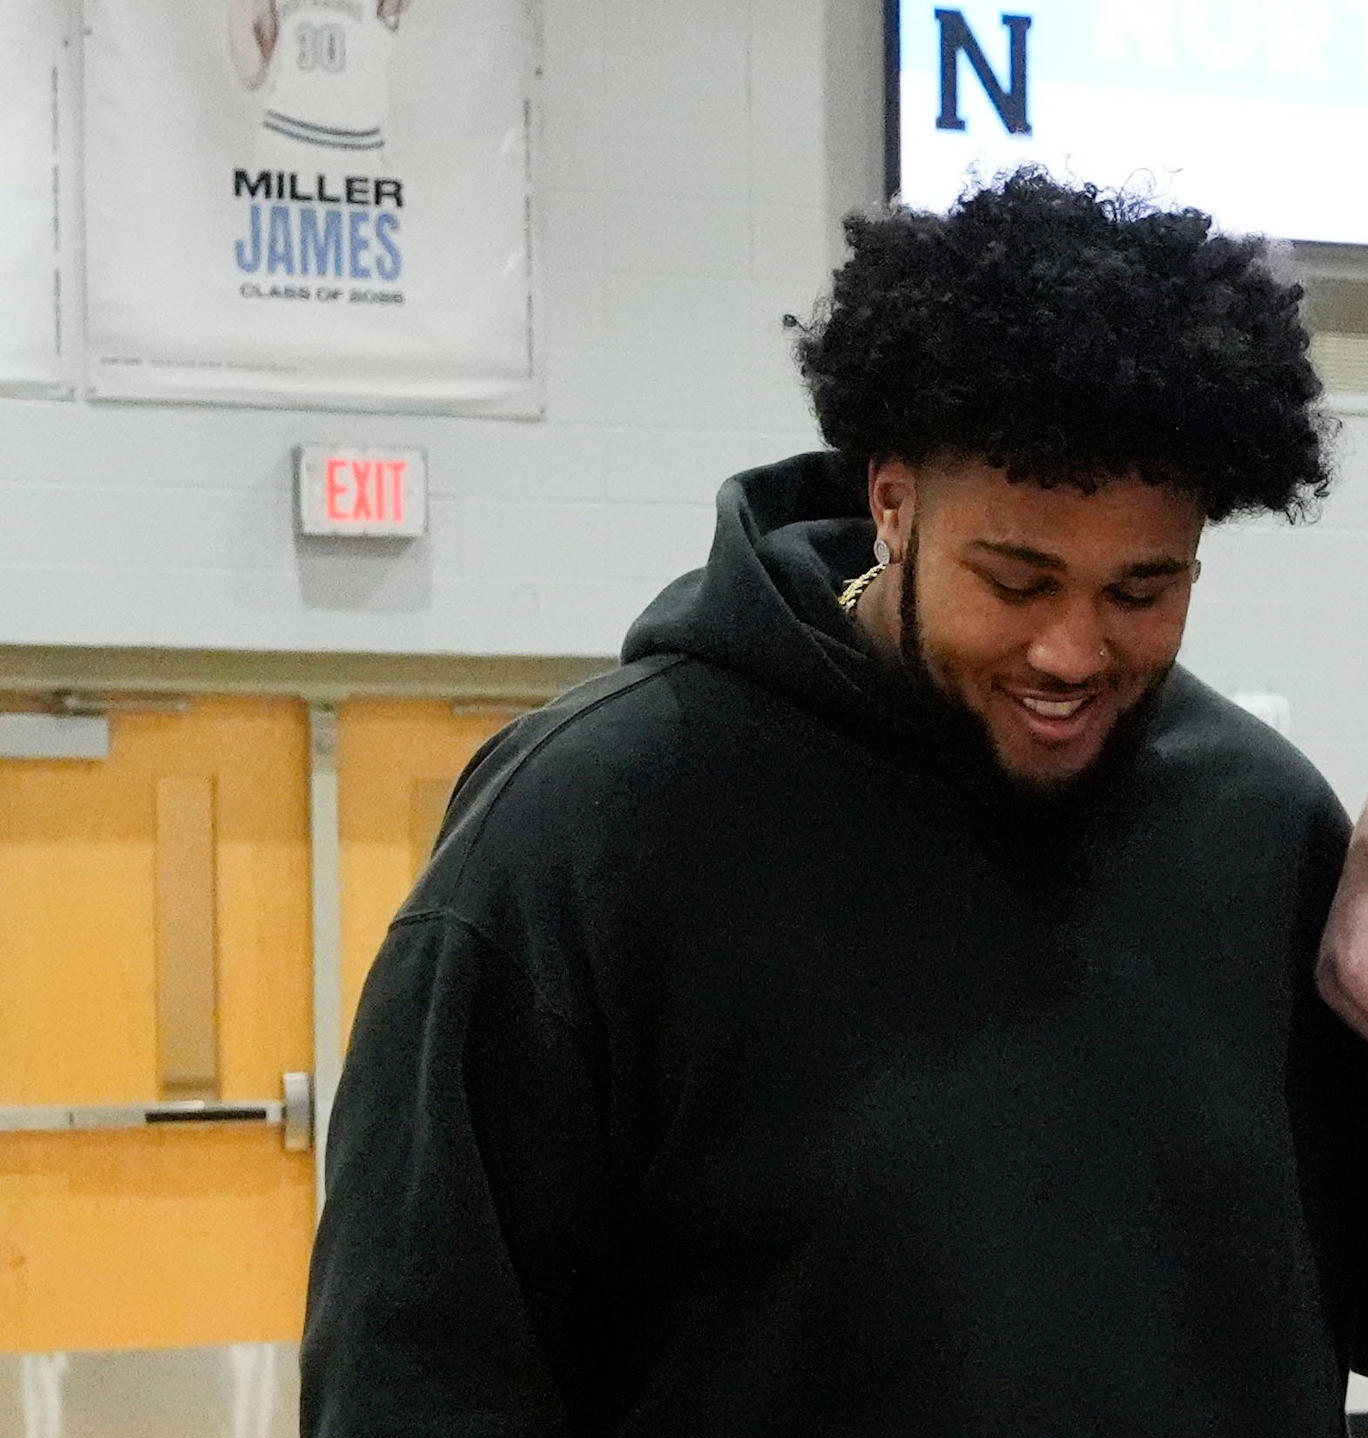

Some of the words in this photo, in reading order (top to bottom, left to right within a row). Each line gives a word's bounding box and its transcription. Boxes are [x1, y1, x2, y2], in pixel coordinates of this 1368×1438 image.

[934, 9, 1032, 137] N
[234, 169, 403, 207] MILLER
[235, 204, 402, 281] JAMES
[239, 283, 310, 300] CLASS
[315, 286, 344, 301] OF
[326, 459, 406, 522] EXIT
